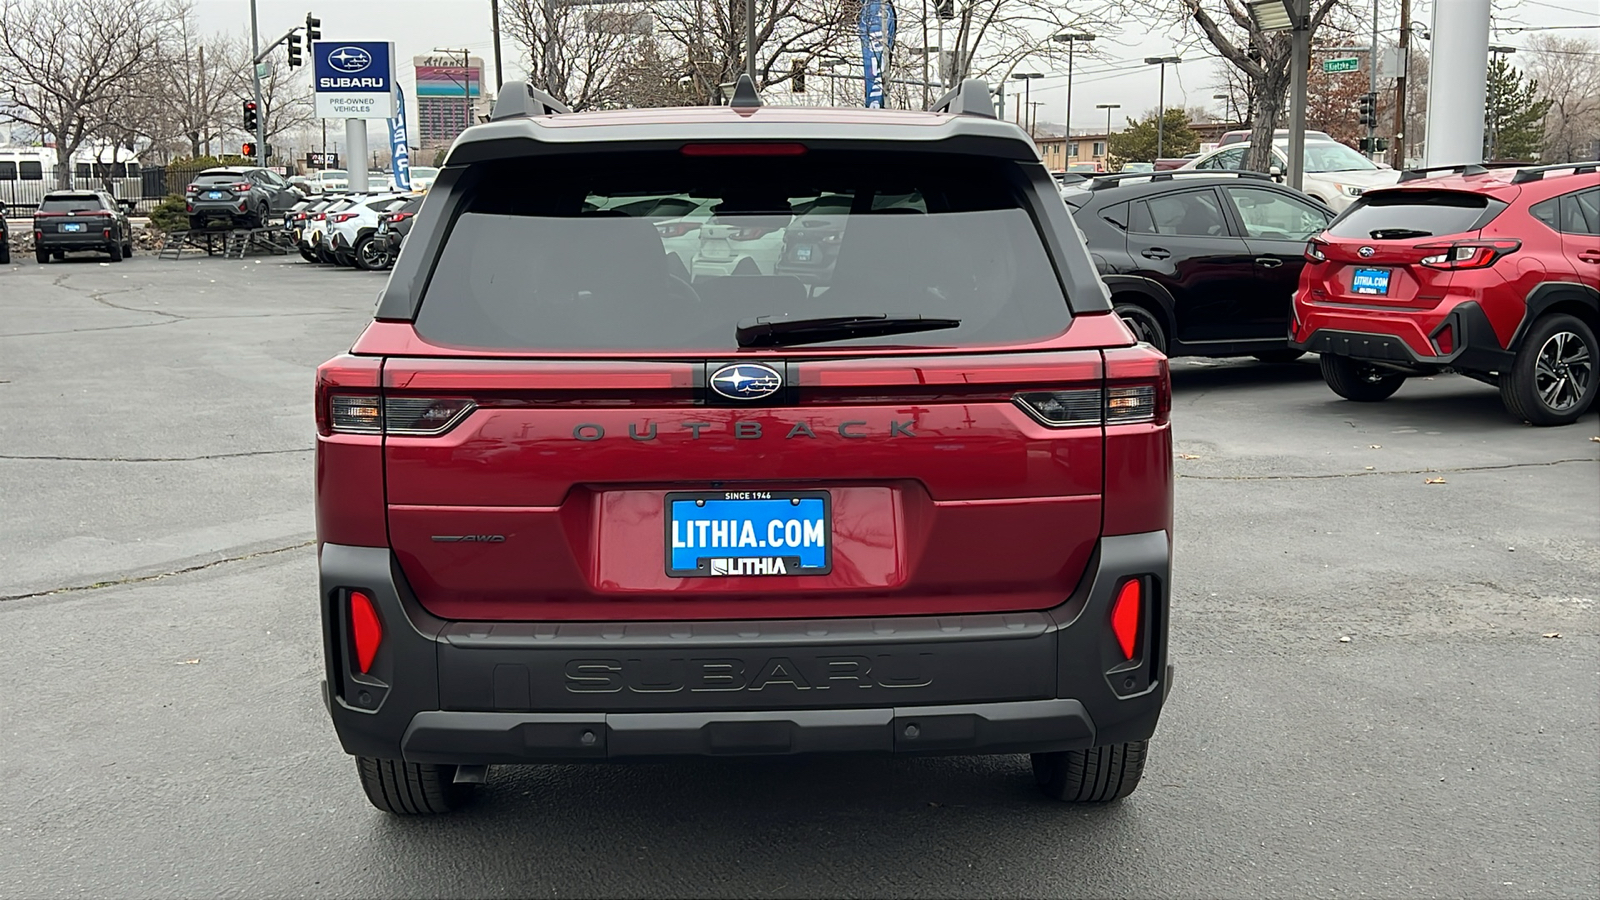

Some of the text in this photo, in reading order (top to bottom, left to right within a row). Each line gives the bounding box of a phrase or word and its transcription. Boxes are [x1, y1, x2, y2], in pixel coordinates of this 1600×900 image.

[320, 77, 384, 88] SUBARU
[333, 105, 371, 113] VEHICLES
[1353, 275, 1389, 287] LITHIA.COM
[573, 420, 917, 442] OUTBACK
[725, 492, 750, 500] SINCE
[460, 534, 506, 542] AWD
[672, 519, 825, 548] LITHIA.COM
[727, 558, 787, 575] LITHIA
[564, 652, 934, 693] SUBARU
